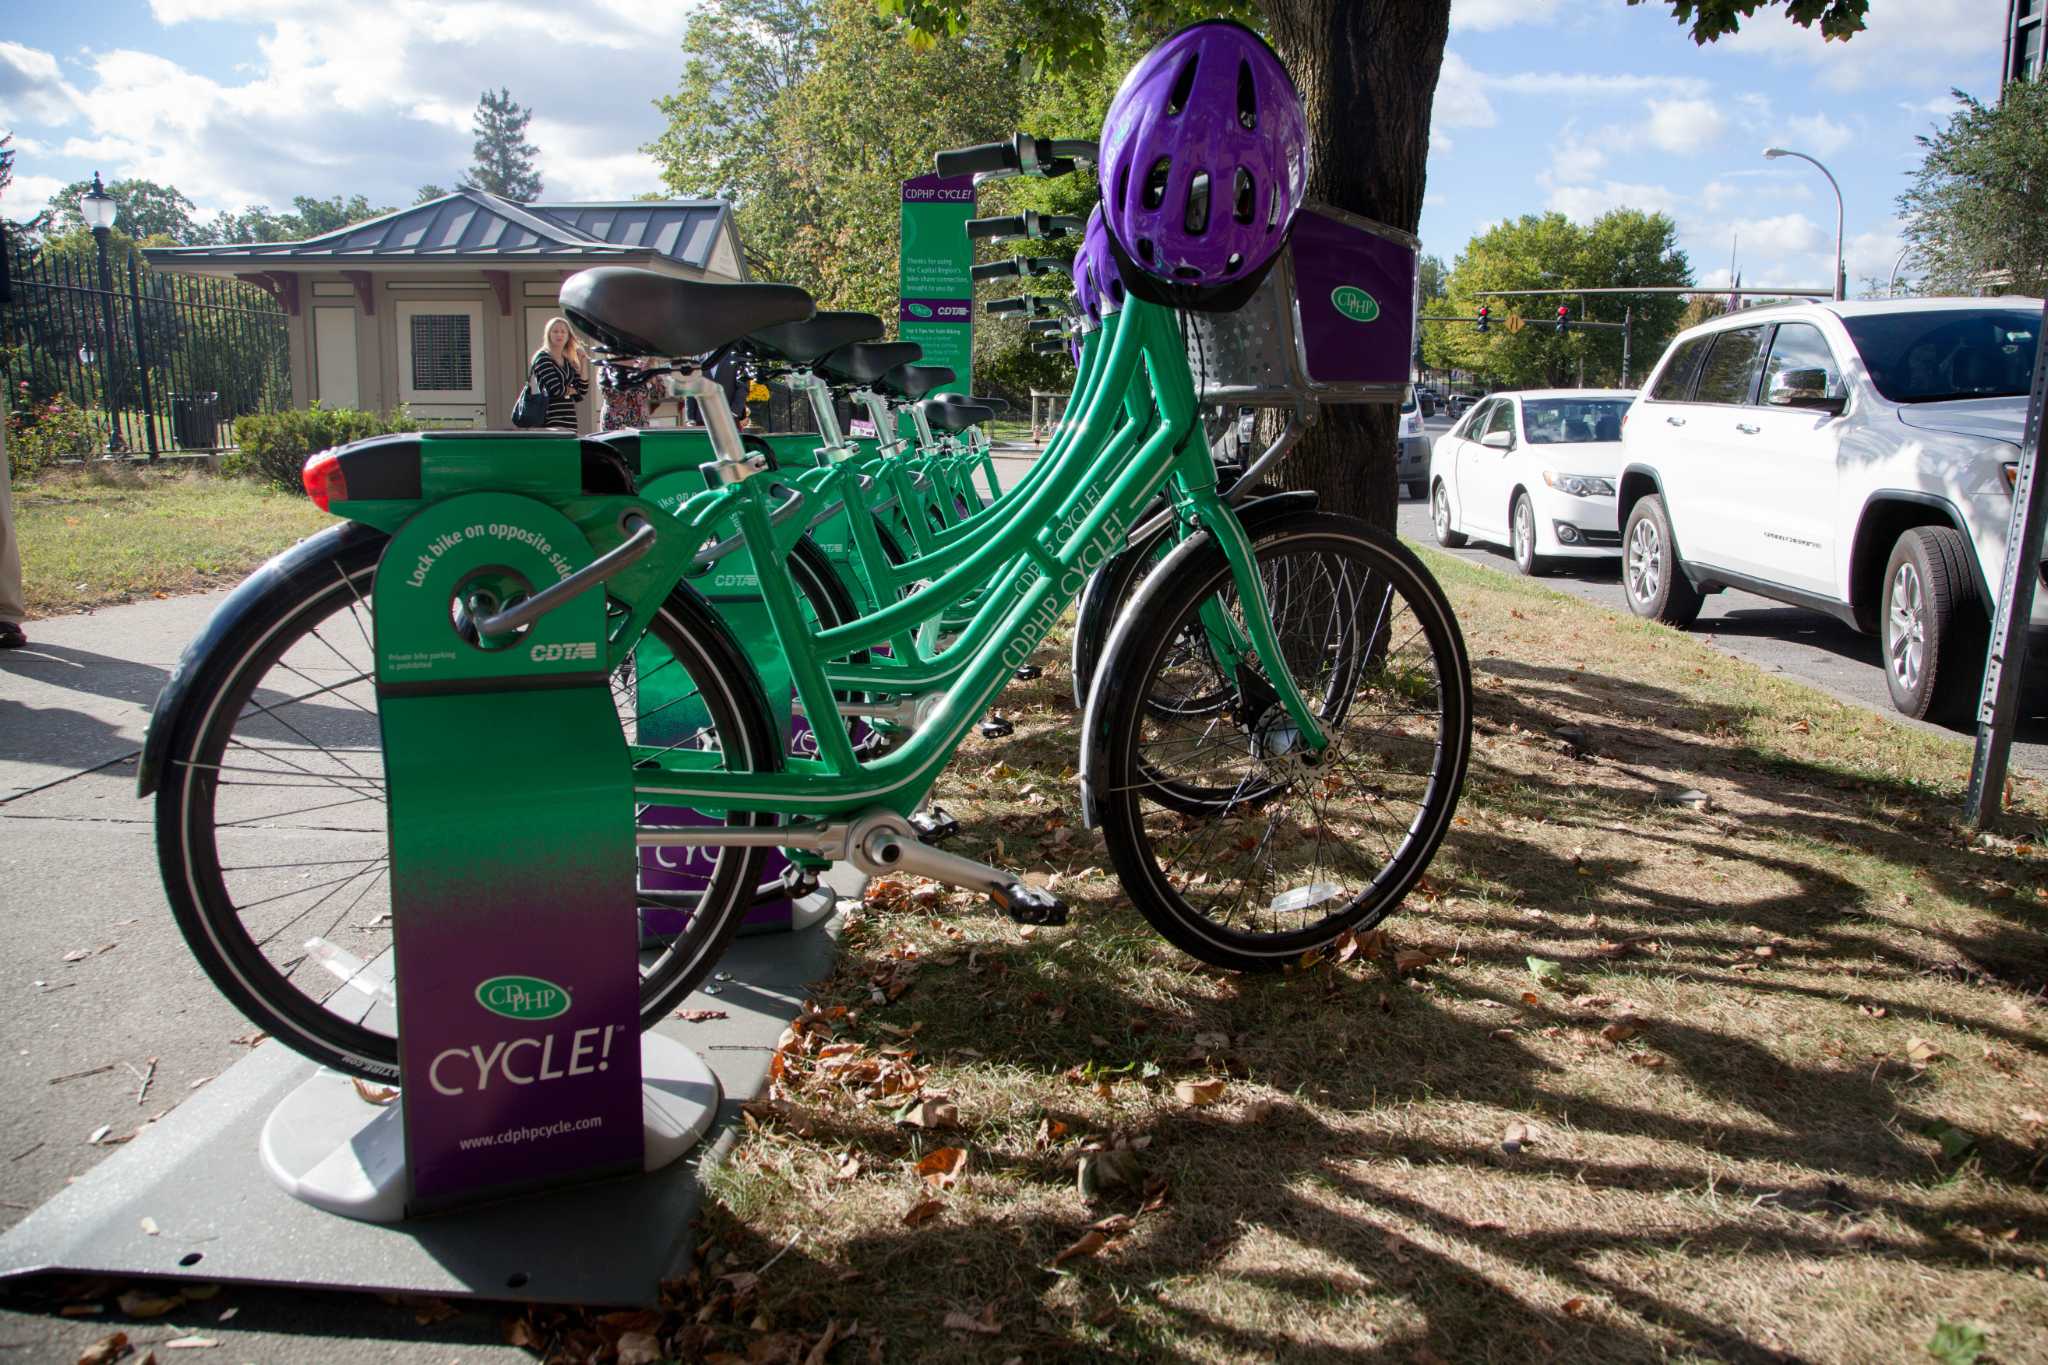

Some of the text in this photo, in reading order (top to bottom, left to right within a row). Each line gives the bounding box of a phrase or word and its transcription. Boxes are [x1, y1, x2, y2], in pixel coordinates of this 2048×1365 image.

[905, 188, 972, 199] CDPHP CYCLE!
[1337, 292, 1374, 314] CDPHP
[406, 555, 436, 588] Lock
[428, 531, 463, 558] bike
[465, 523, 485, 538] on
[489, 523, 552, 555] opposite
[1002, 510, 1126, 669] CDPHP CYCLE!
[530, 642, 597, 662] CDTA
[488, 984, 556, 1013] CDPHP
[429, 1025, 615, 1096] CYCLE!
[459, 1115, 603, 1151] www.cdphpcycle.com
